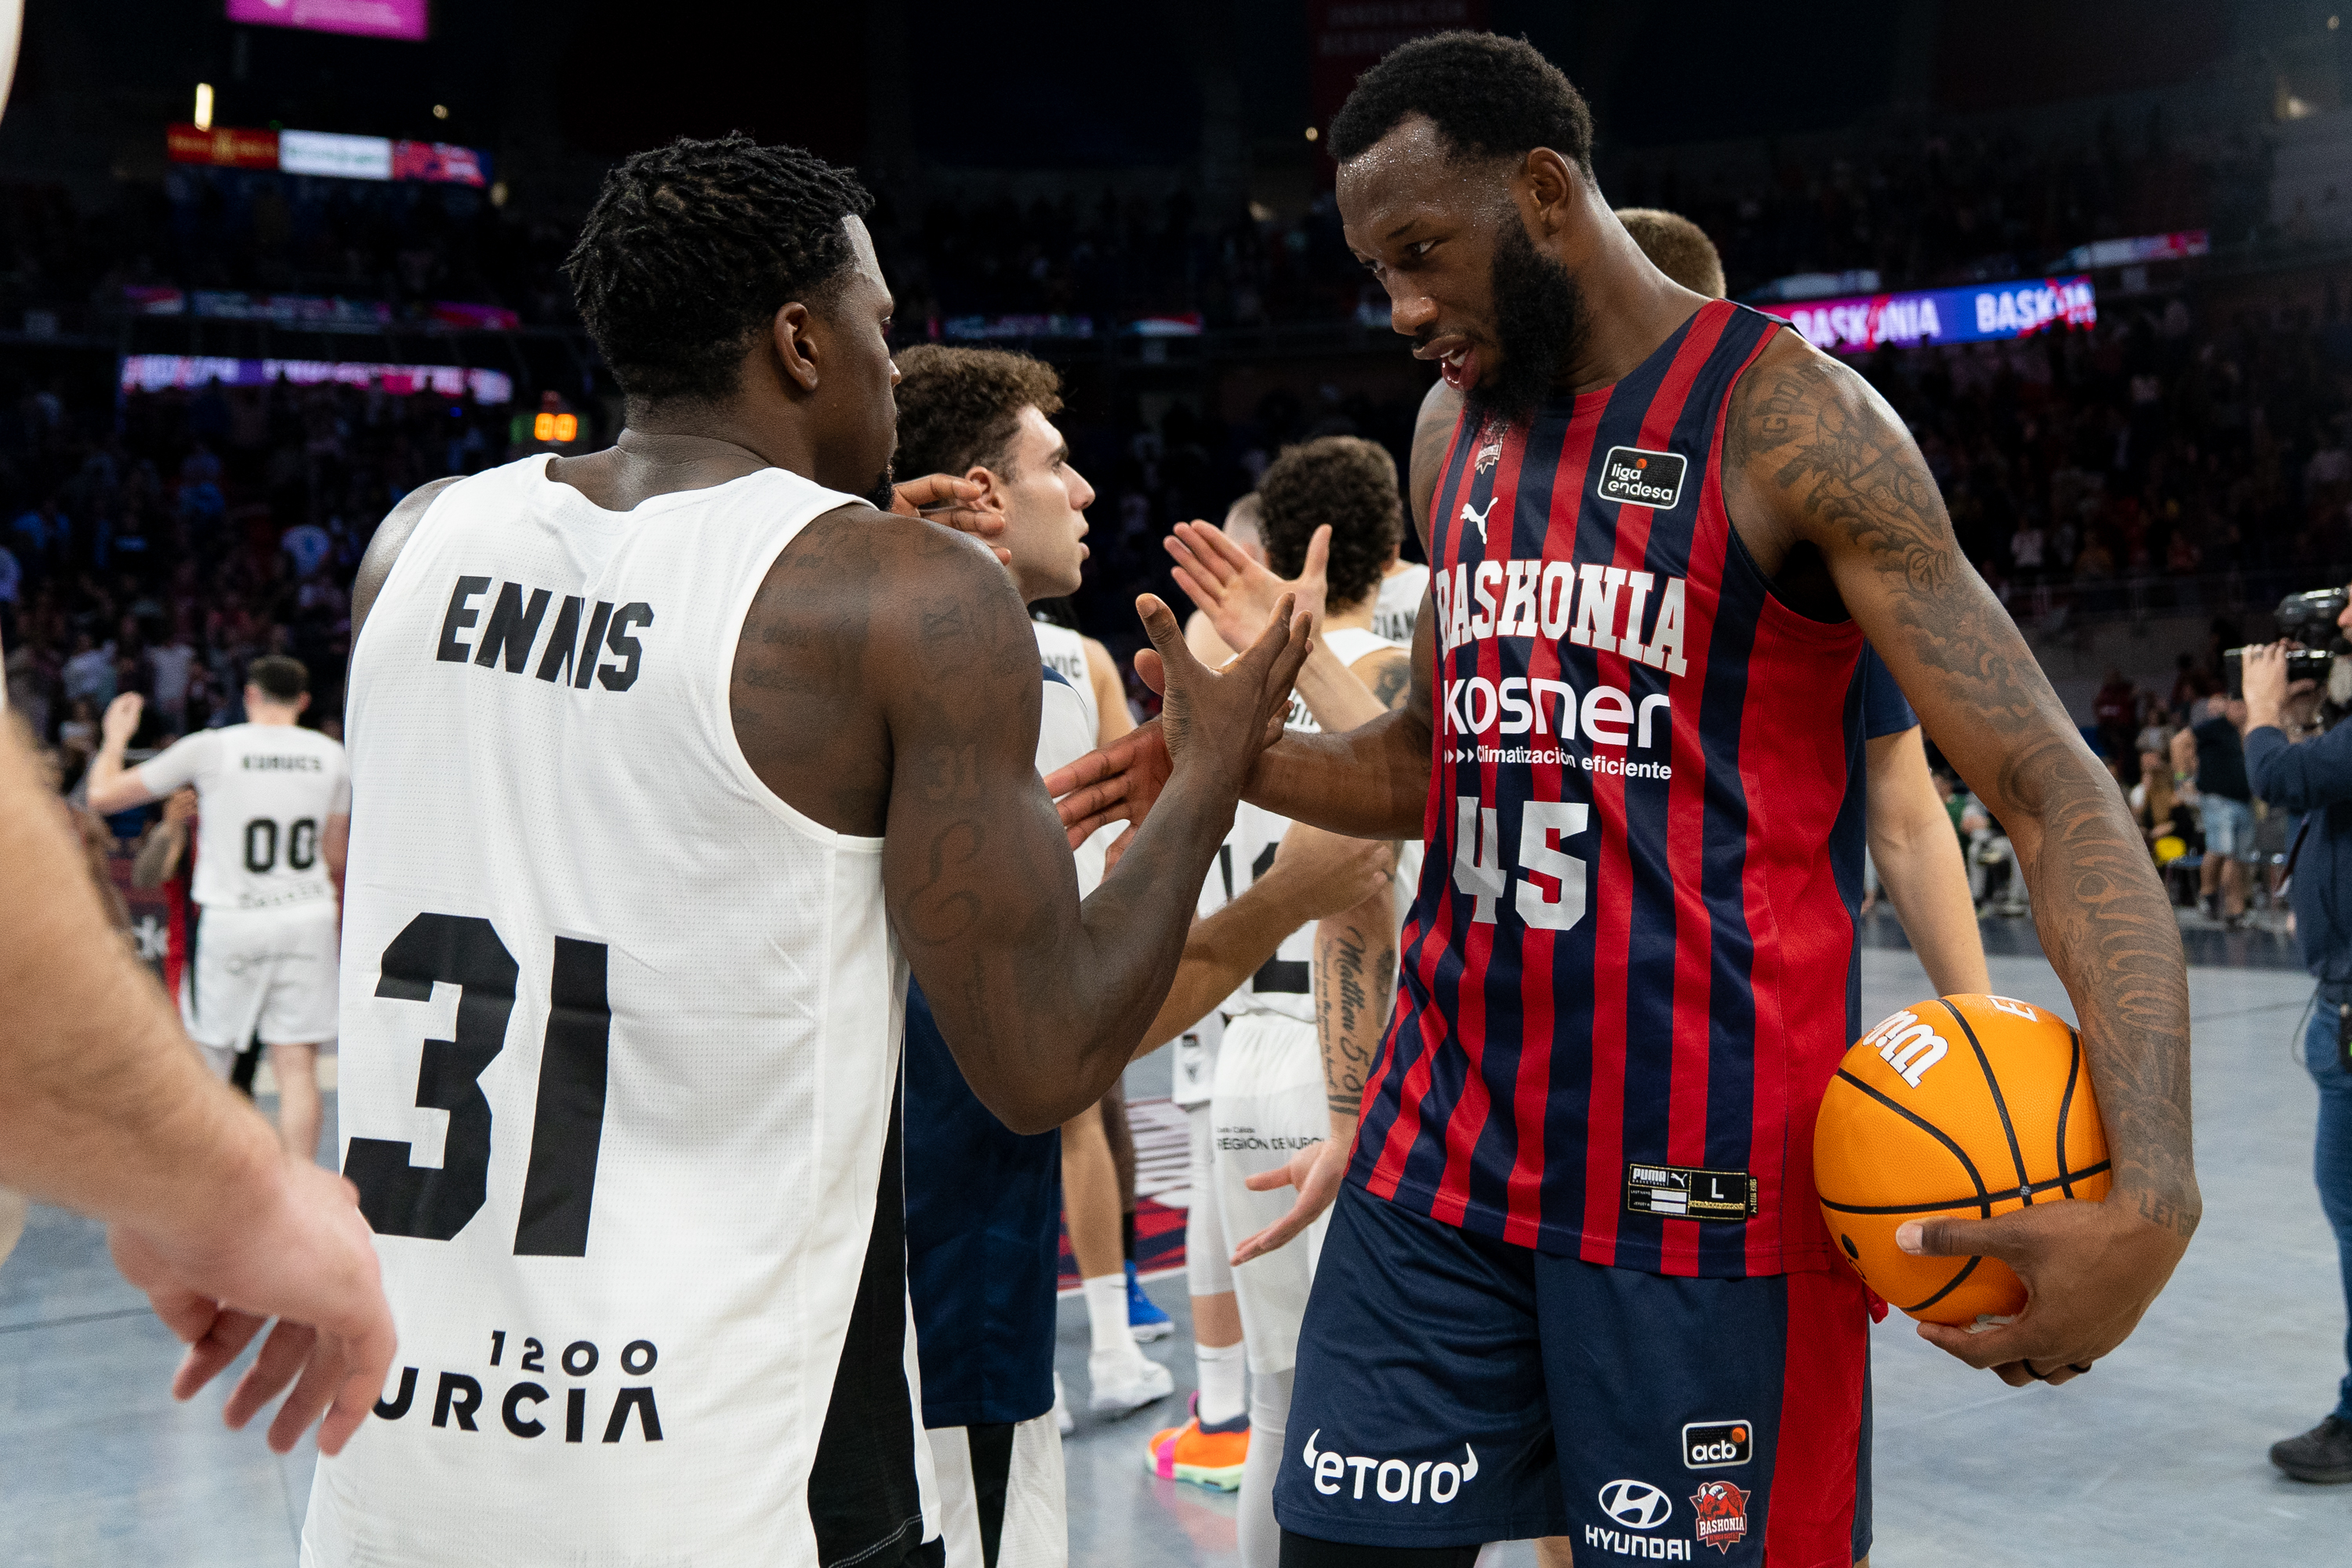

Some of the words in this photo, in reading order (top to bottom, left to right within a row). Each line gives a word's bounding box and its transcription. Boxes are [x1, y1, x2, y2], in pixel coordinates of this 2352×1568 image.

[1976, 283, 2096, 332] BASK
[1608, 481, 1673, 500] endesa
[1611, 463, 1642, 481] liga
[436, 575, 655, 691] ENNIS
[1436, 560, 1688, 677] BASKONIA
[1476, 745, 1576, 768] Climatización
[1581, 756, 1672, 779] eficiente
[245, 818, 318, 873] 00
[1453, 796, 1589, 931] 45
[339, 912, 612, 1258] 31
[1287, 1137, 1325, 1149] MUR
[1633, 1167, 1666, 1183] PUMA
[1711, 1178, 1724, 1199] L
[489, 1330, 659, 1377] 1200
[372, 1366, 664, 1443] URCIA
[1692, 1439, 1737, 1461] acb
[1585, 1524, 1690, 1560] HYUNDAI
